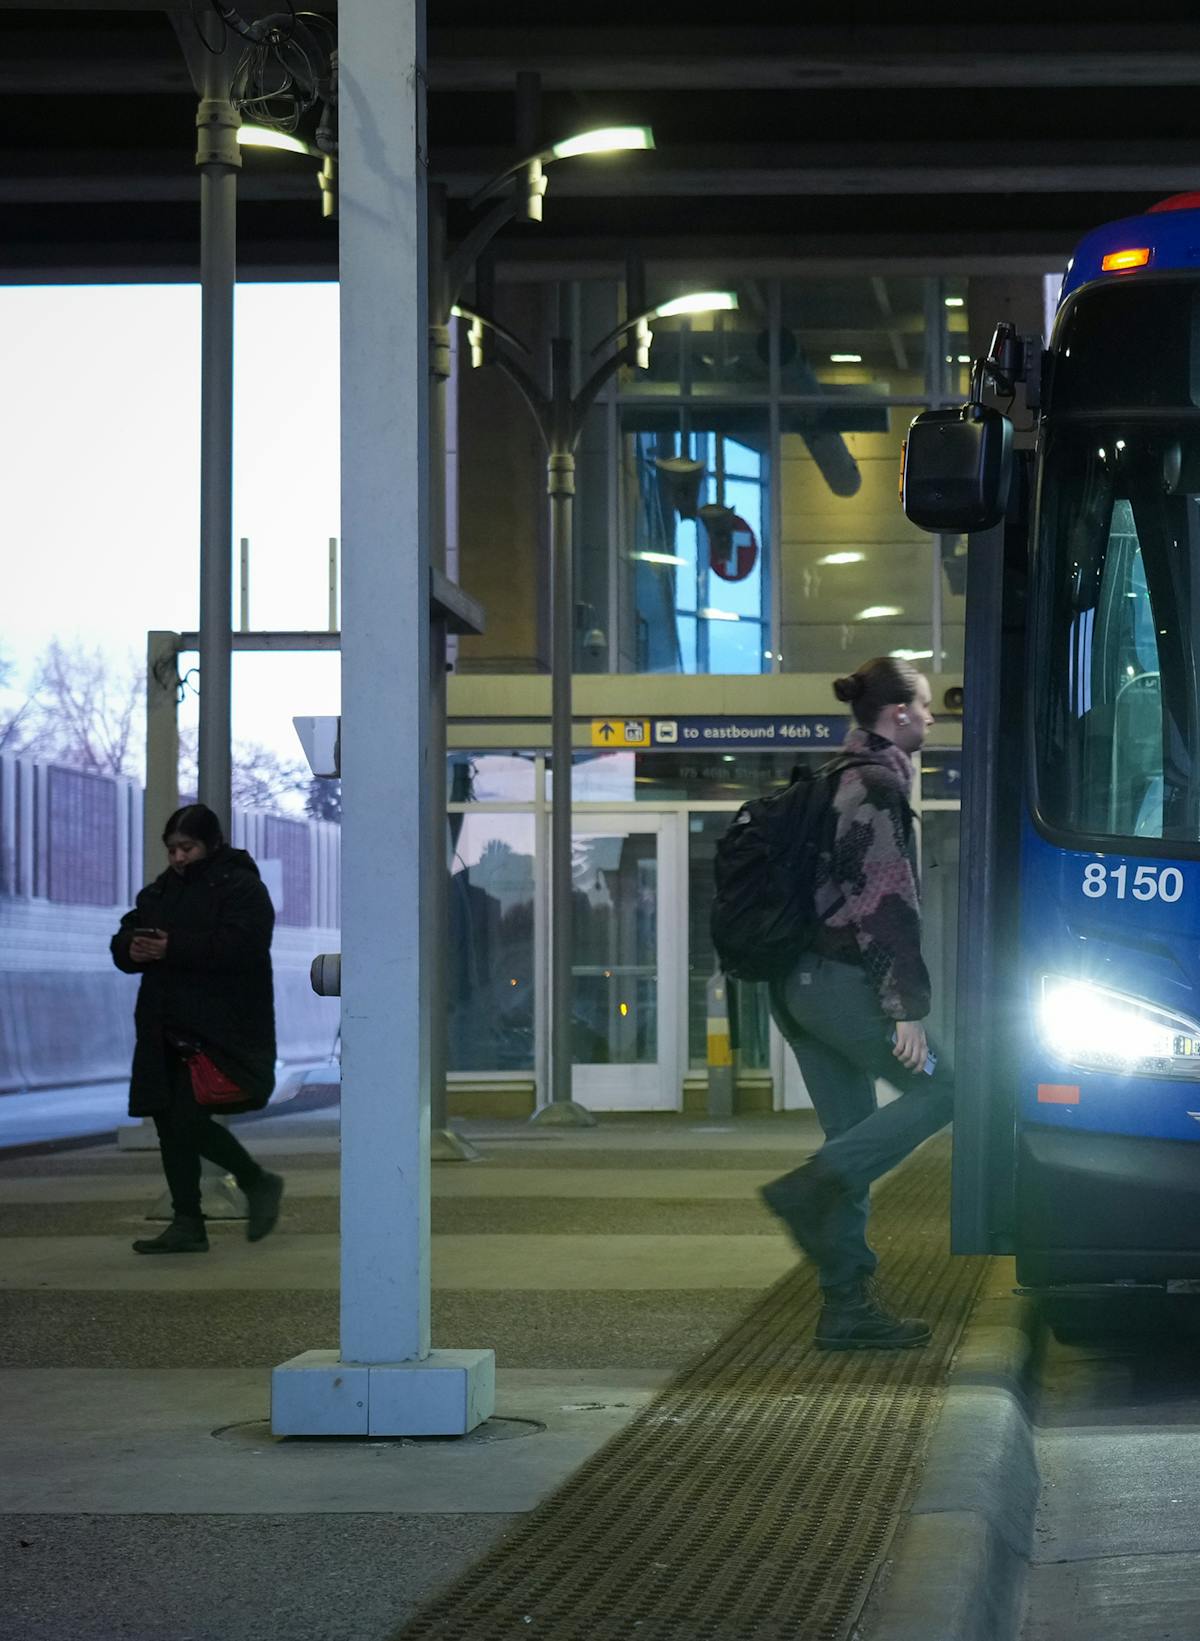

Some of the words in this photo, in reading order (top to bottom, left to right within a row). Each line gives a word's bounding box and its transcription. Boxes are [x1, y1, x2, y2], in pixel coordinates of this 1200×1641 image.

[683, 726, 699, 739] to
[703, 723, 775, 739] eastbound
[779, 723, 811, 739] 46th
[815, 723, 830, 739] St
[1082, 863, 1184, 903] 8150
